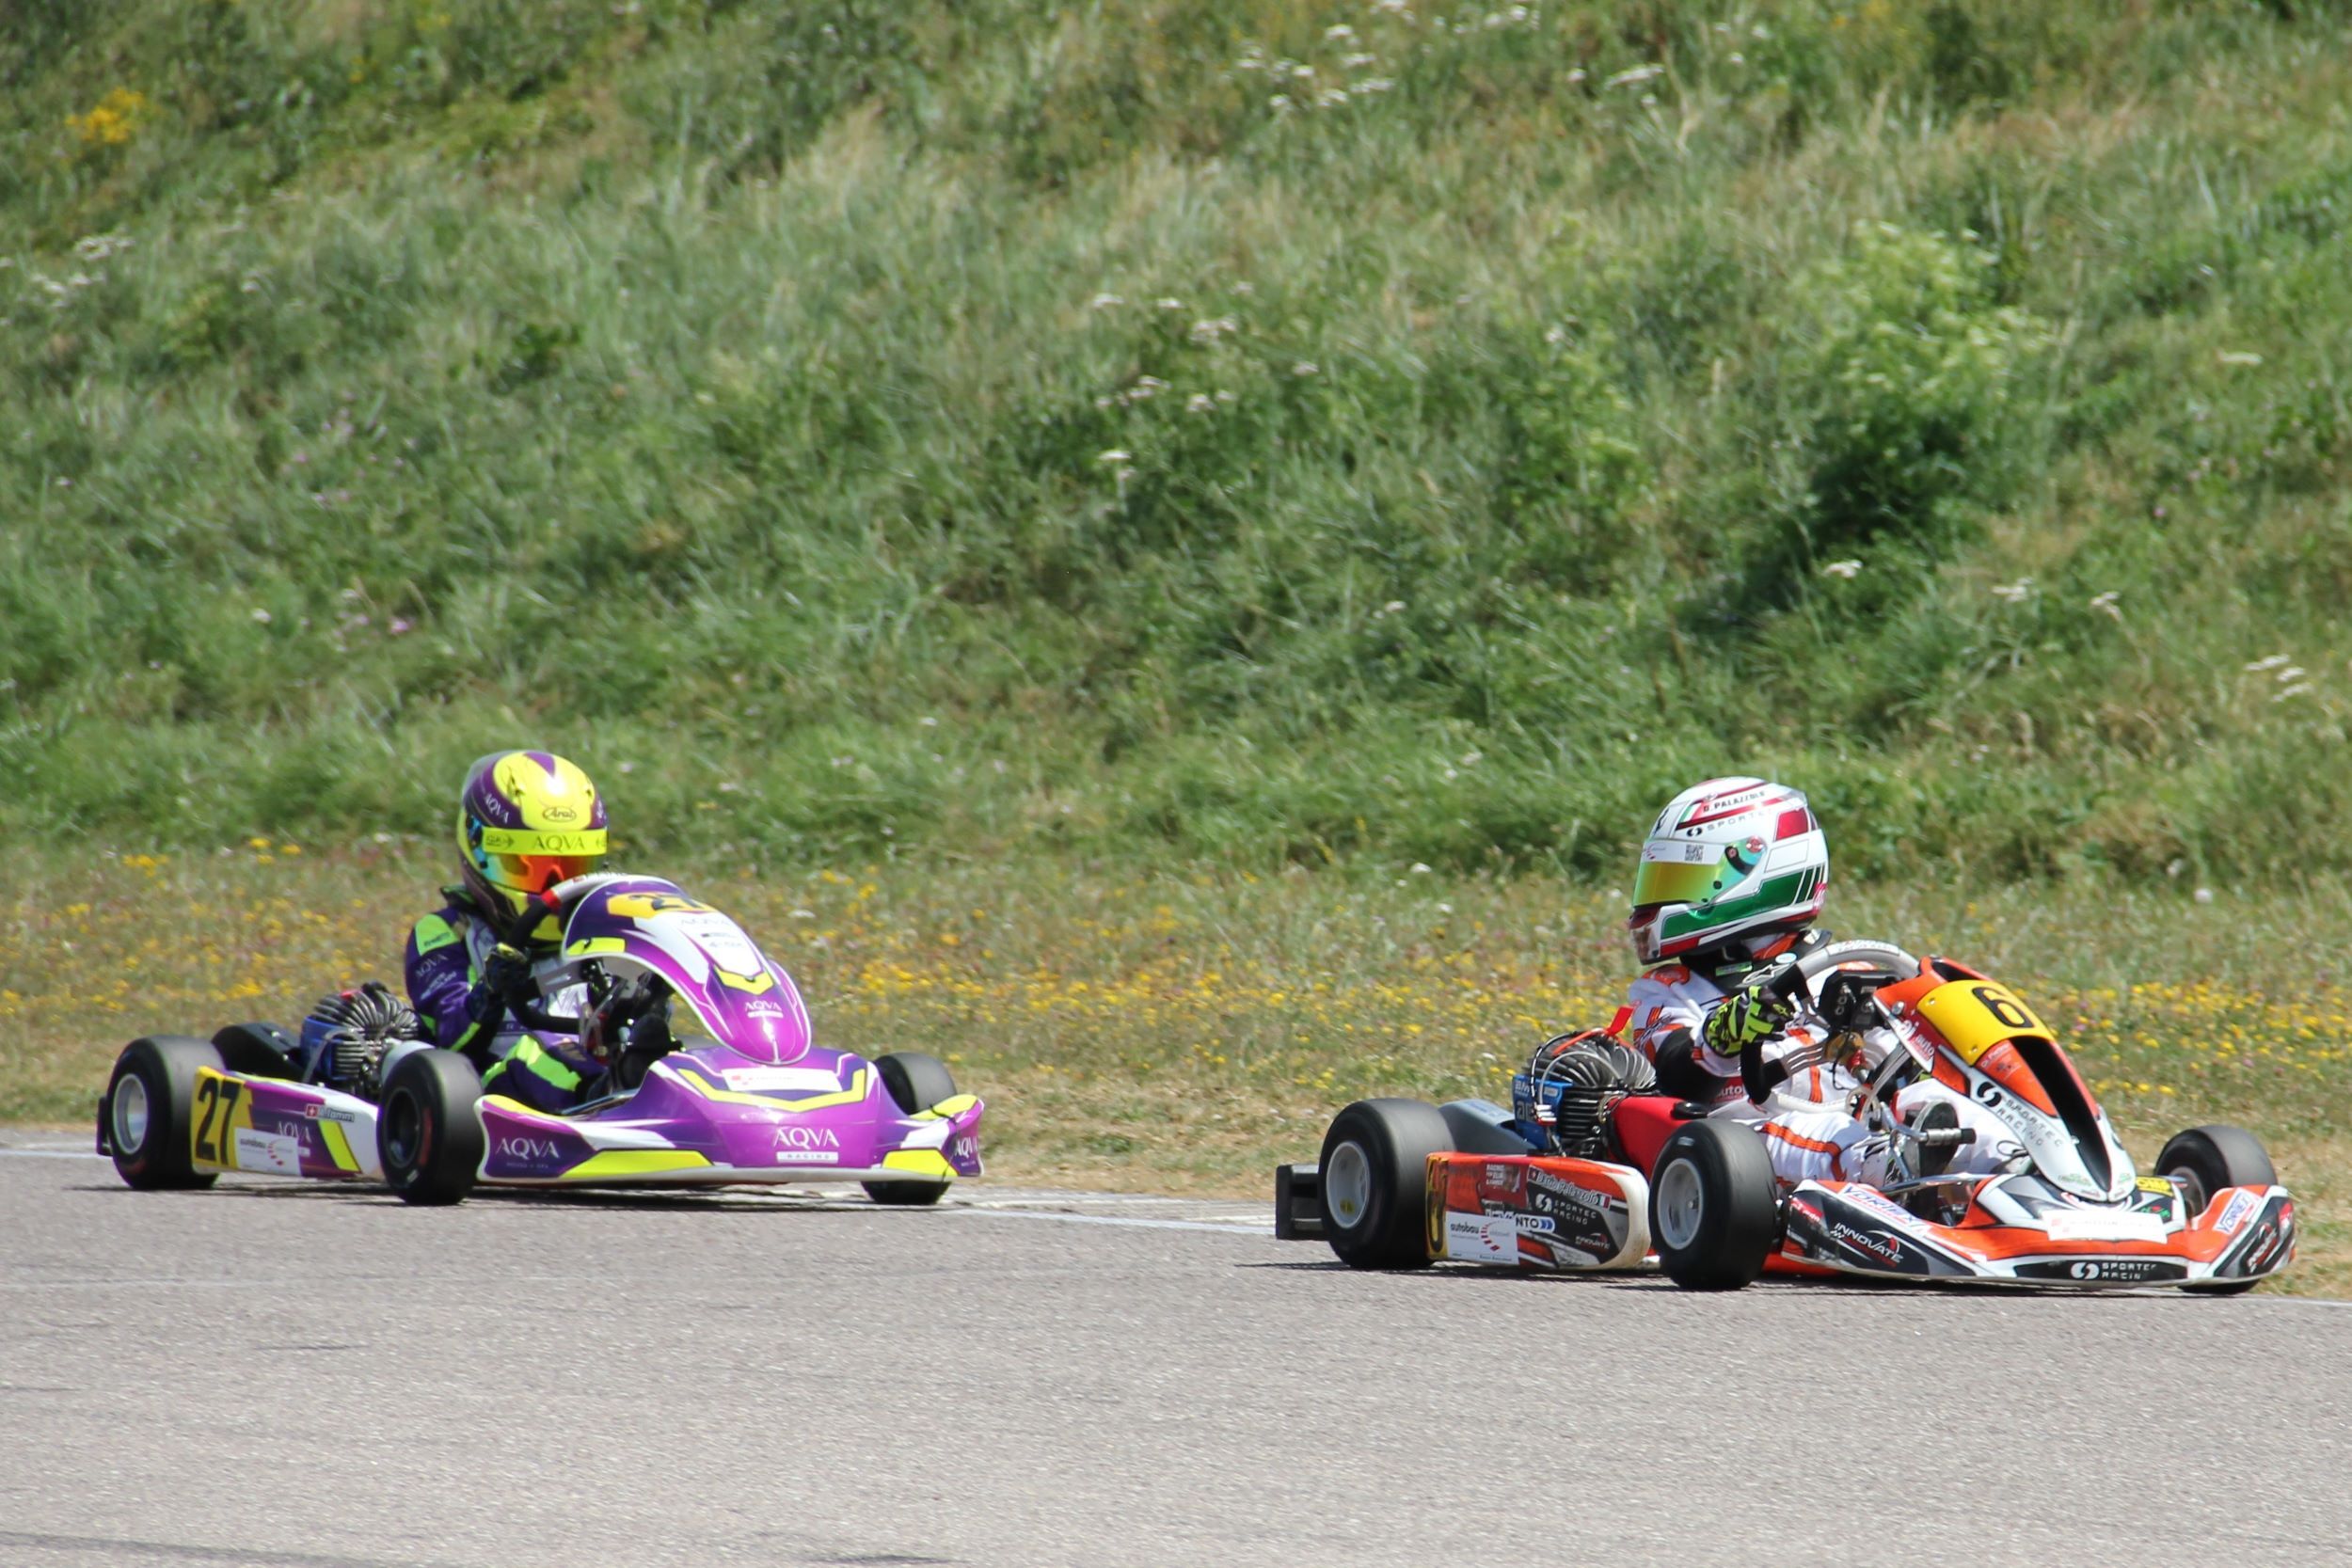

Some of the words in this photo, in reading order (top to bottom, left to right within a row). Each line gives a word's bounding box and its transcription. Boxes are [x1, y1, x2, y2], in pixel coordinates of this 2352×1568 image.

[1707, 810, 1766, 832] SPORTE
[532, 834, 585, 851] AQVA
[745, 1000, 782, 1011] AQVA
[1971, 986, 2035, 1028] 6
[196, 1077, 242, 1165] 27
[2006, 1099, 2064, 1148] SPORTEC
[495, 1136, 561, 1161] AQVA
[774, 1127, 840, 1149] AQVA
[1553, 1208, 1588, 1226] RACING
[1554, 1199, 1597, 1219] SPORTEC
[1834, 1222, 1904, 1263] INNOVATE
[2101, 1271, 2142, 1280] RACIN
